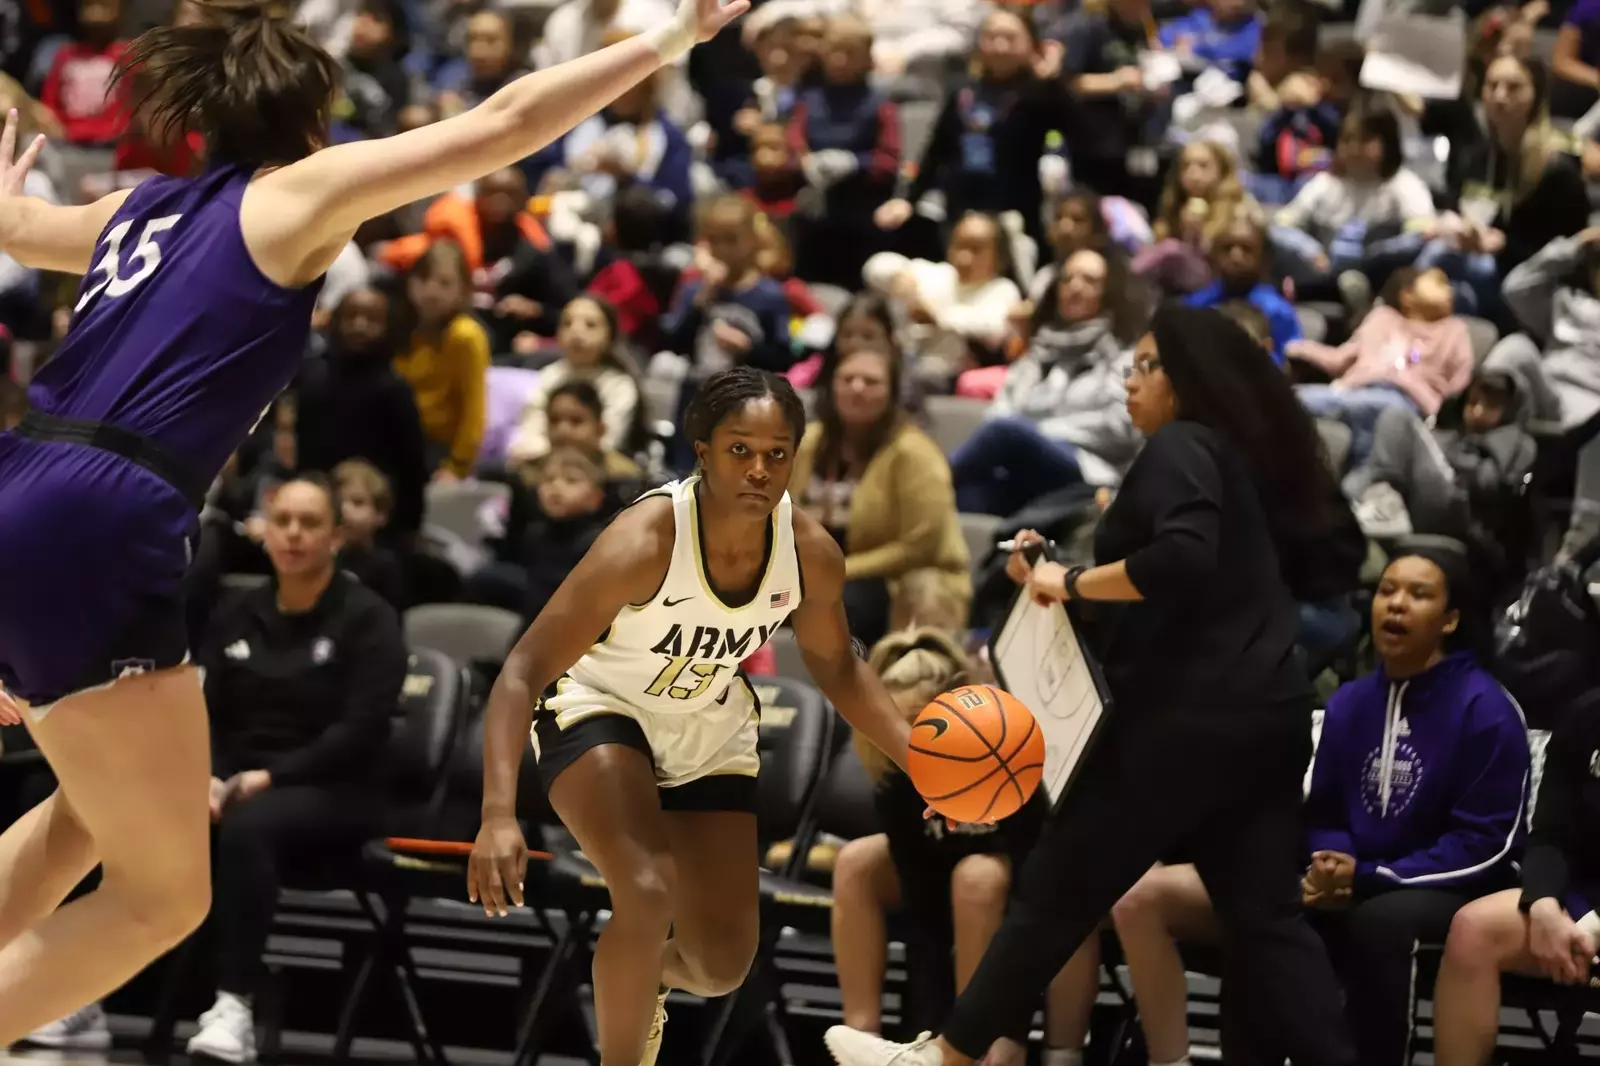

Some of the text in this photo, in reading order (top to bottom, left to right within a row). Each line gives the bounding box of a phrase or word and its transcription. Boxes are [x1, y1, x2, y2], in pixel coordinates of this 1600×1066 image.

[74, 213, 184, 313] 35
[649, 620, 781, 660] ARMY
[643, 656, 730, 700] 13
